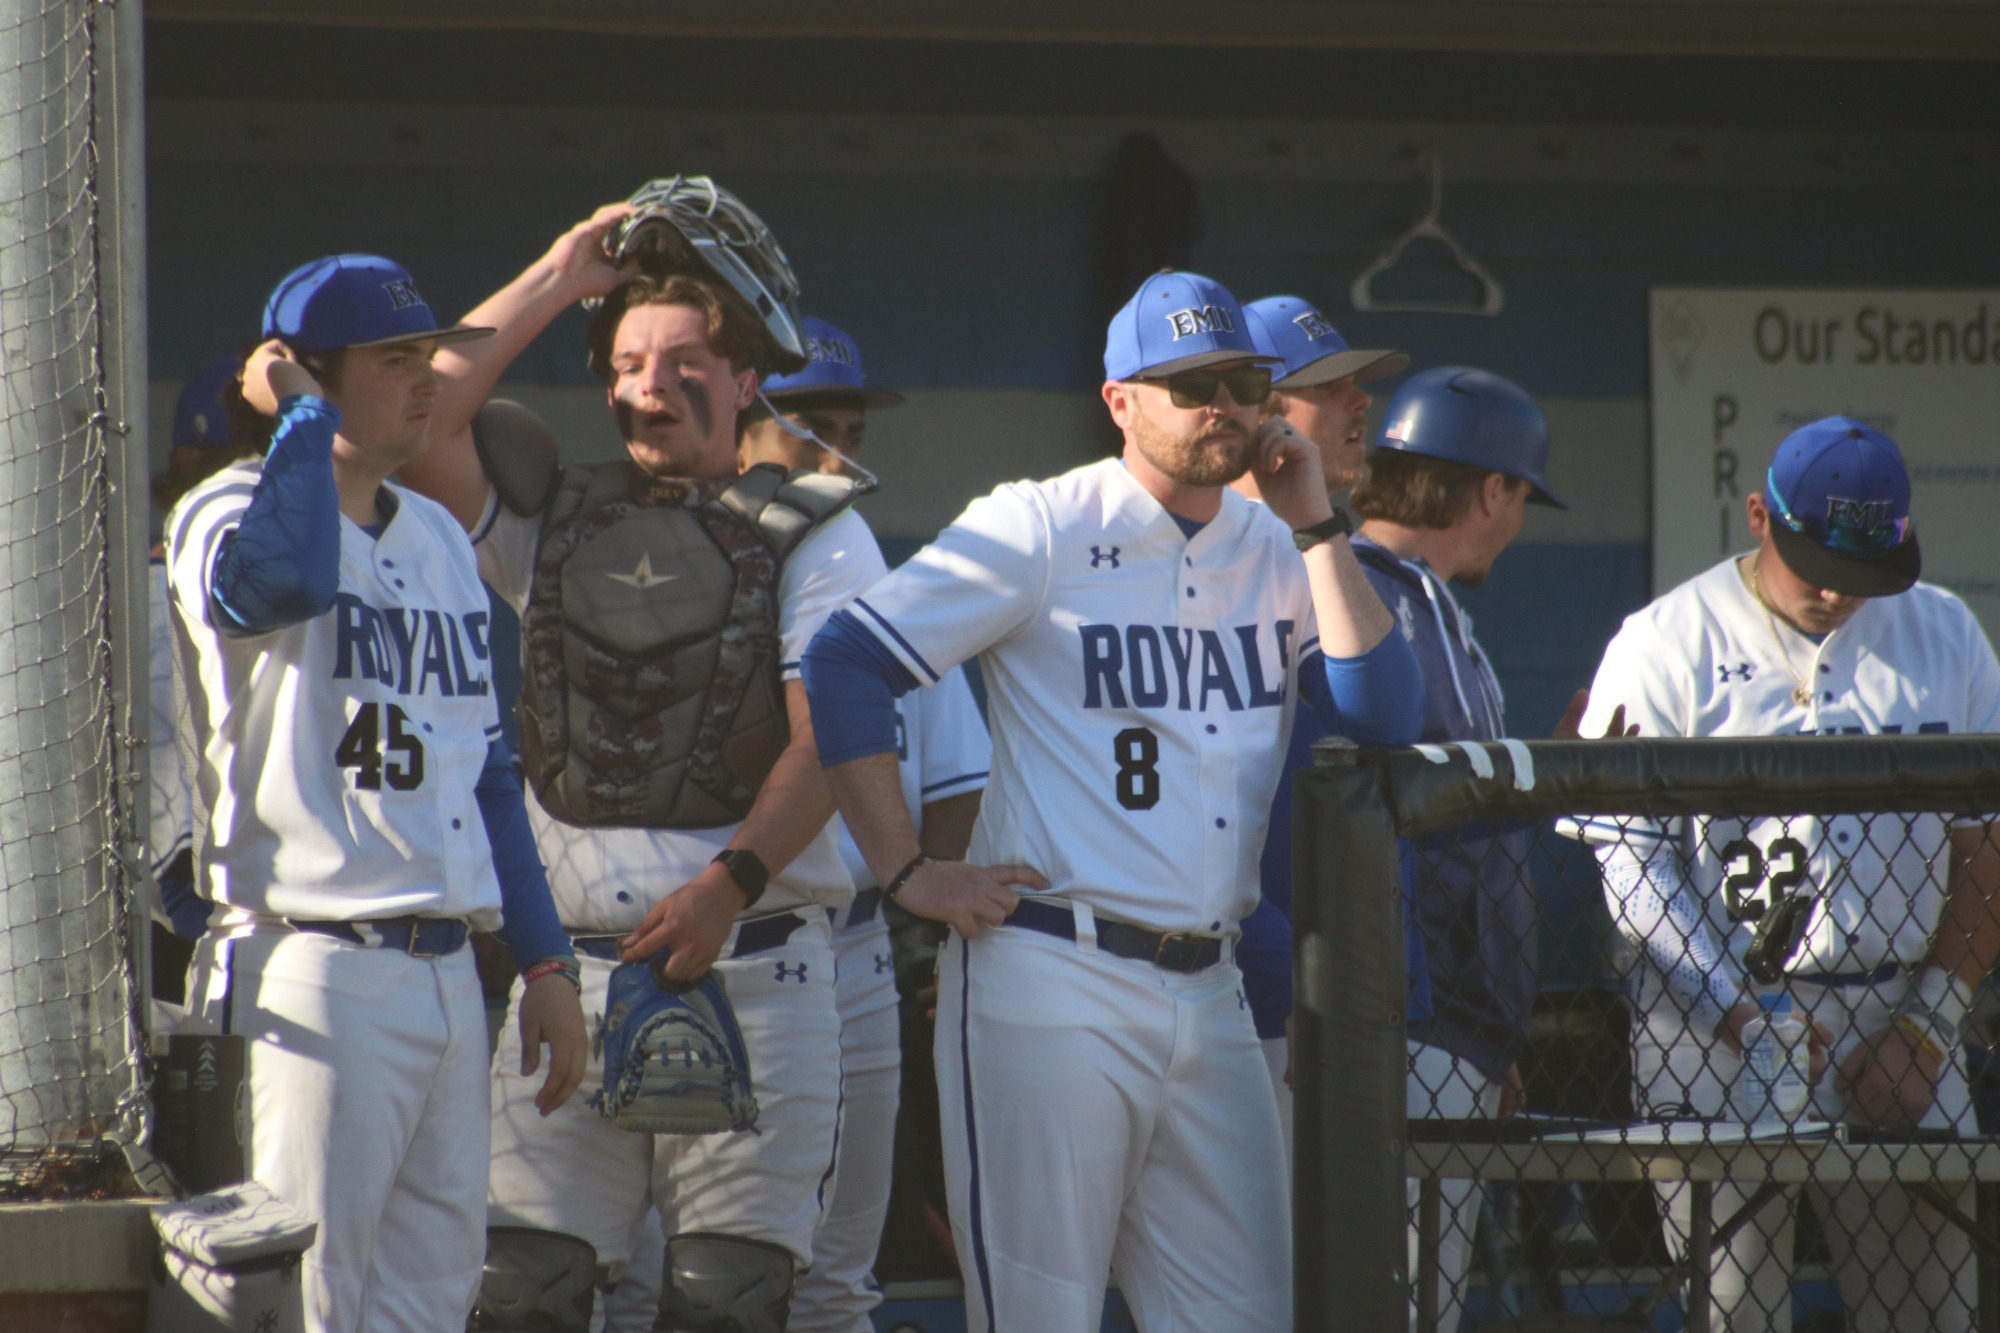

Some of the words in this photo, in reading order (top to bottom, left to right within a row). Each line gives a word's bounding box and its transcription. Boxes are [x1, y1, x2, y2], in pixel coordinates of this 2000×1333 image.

[1165, 305, 1235, 341] EMU
[1754, 305, 1841, 365] Our
[332, 592, 488, 697] ROYALS
[335, 702, 424, 791] 45
[1113, 726, 1160, 812] 8
[1721, 837, 1808, 923] 22
